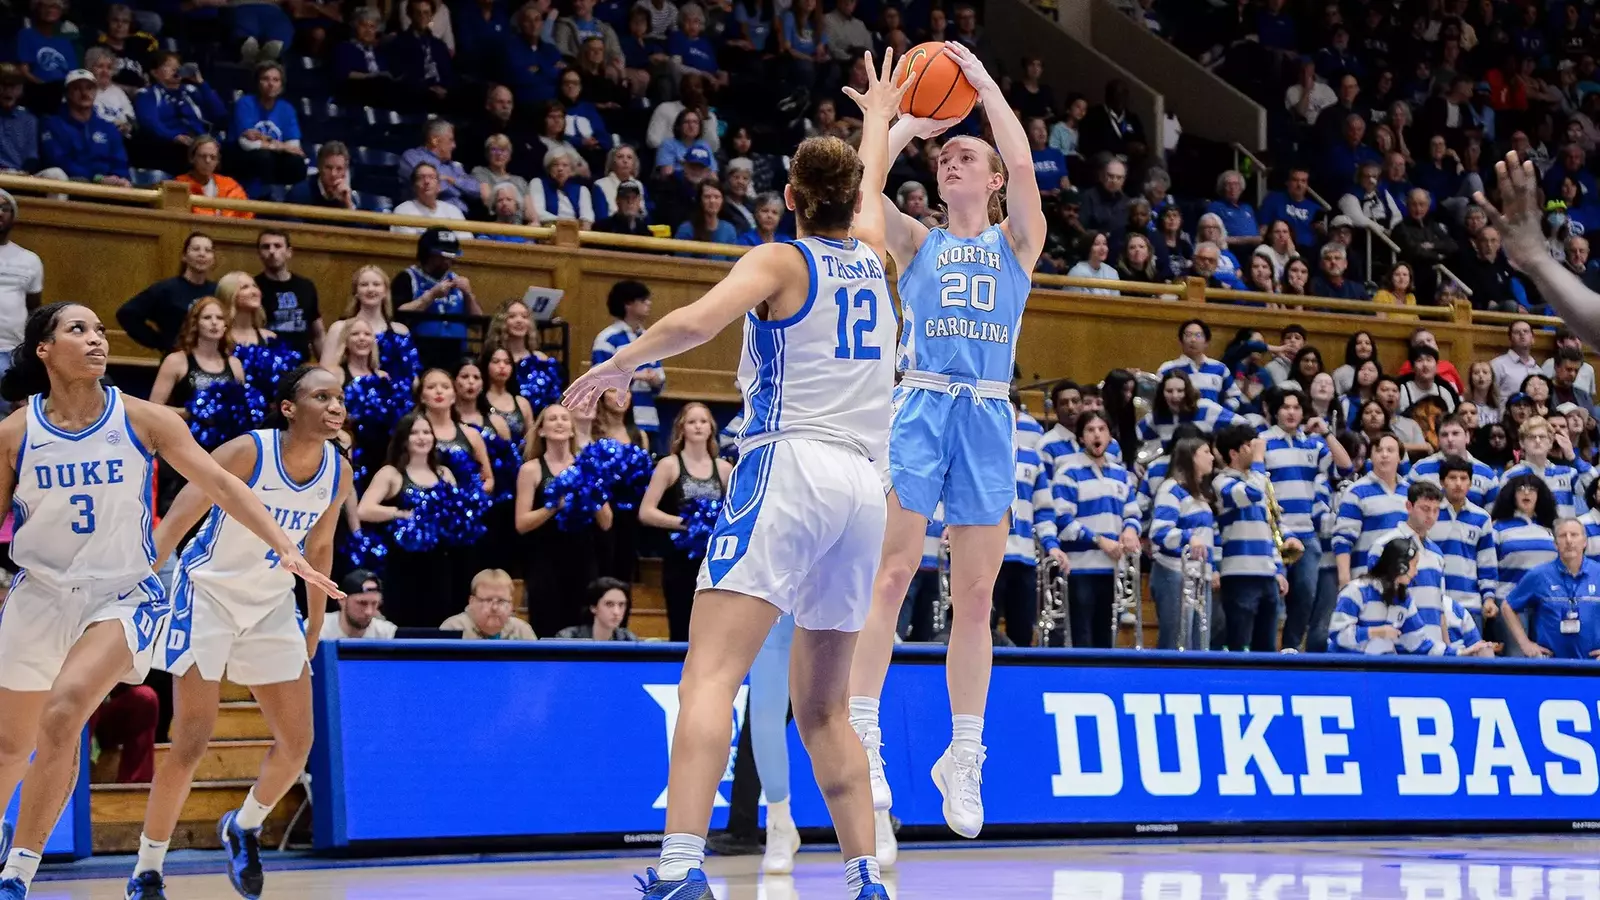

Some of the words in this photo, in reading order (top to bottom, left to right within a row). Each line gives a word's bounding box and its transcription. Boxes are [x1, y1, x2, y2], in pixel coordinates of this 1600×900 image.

[822, 254, 882, 280] THOMAS
[935, 245, 1002, 271] NORTH
[940, 272, 997, 312] 20
[834, 286, 881, 360] 12
[924, 318, 1009, 345] CAROLINA
[35, 458, 124, 489] DUKE
[69, 494, 96, 535] 3
[263, 504, 319, 531] UKE
[711, 535, 739, 562] D
[139, 611, 153, 637] D
[168, 629, 187, 650] D
[1042, 691, 1363, 797] DUKE
[1387, 695, 1600, 797] BAS
